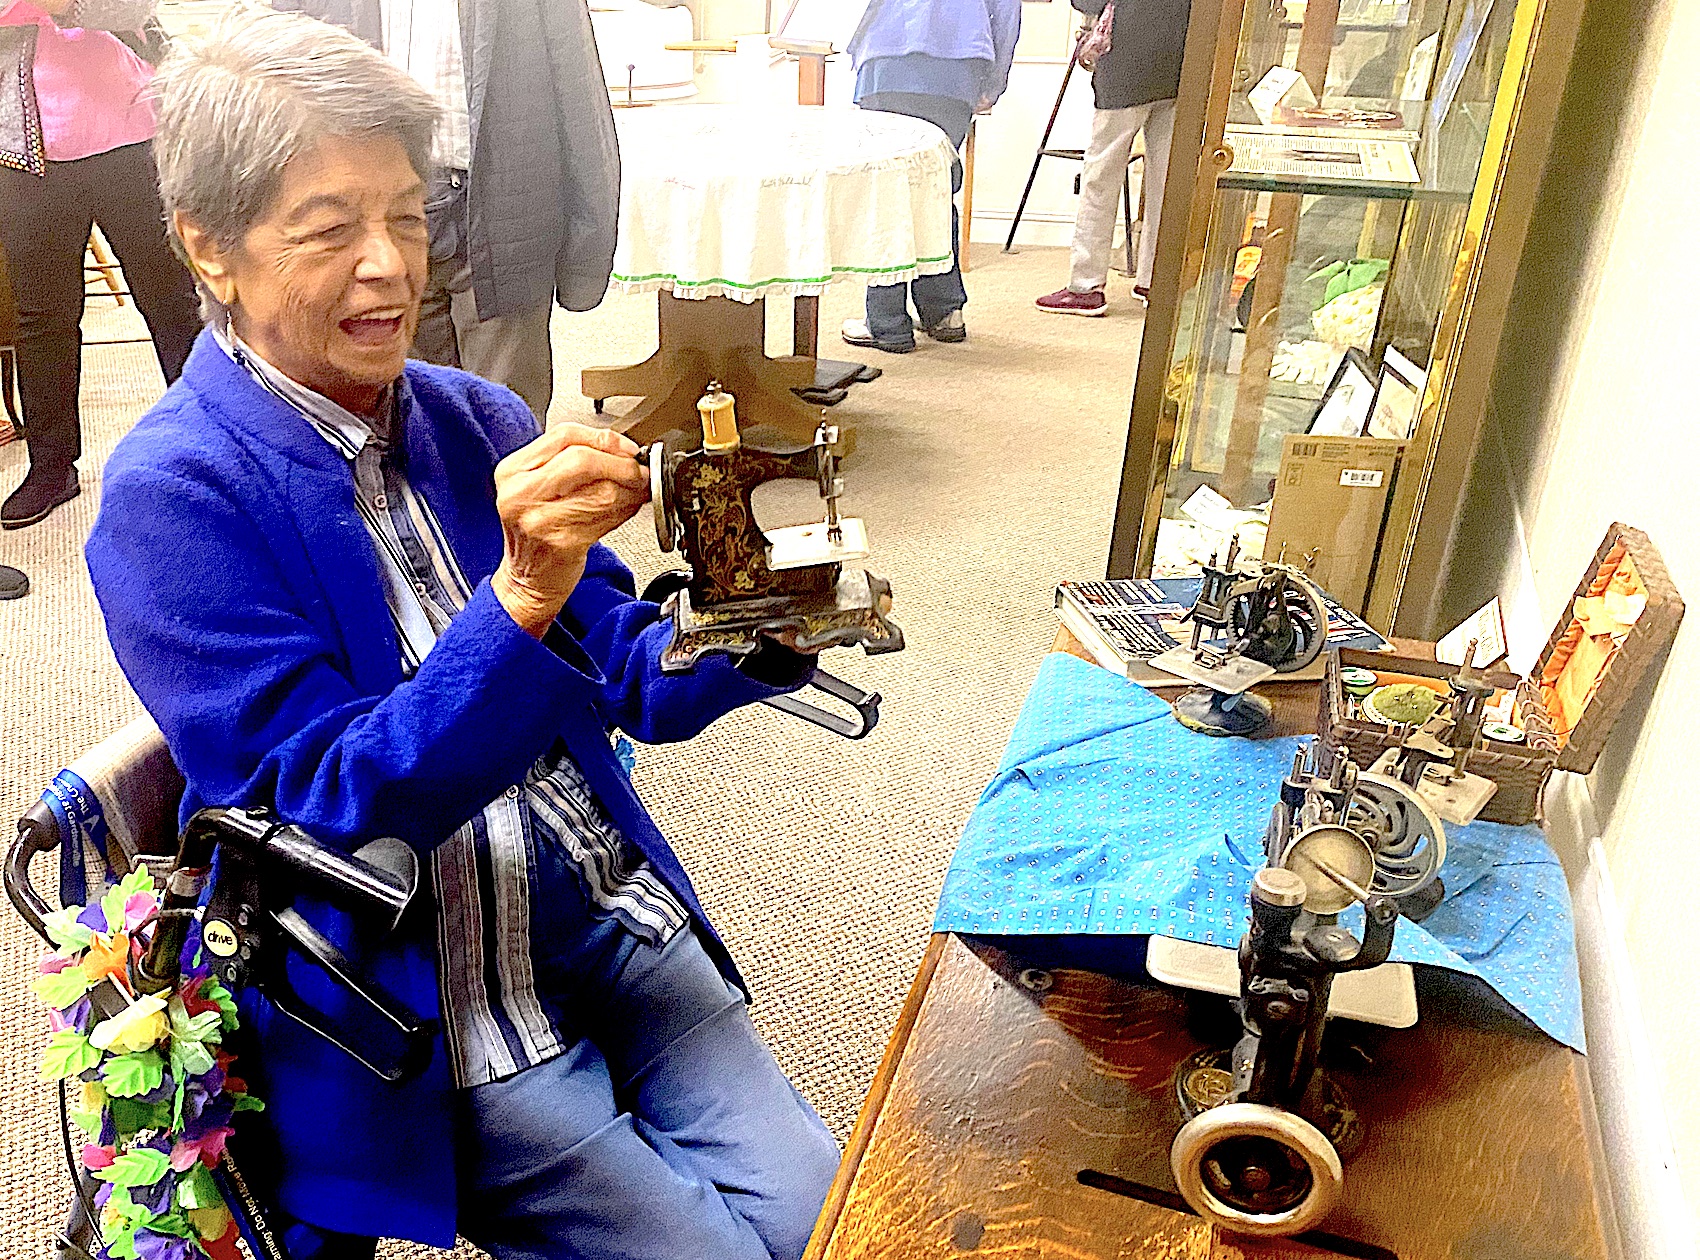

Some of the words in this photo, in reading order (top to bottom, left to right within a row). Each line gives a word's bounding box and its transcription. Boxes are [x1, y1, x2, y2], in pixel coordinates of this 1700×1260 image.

[77, 796, 89, 815] The
[207, 930, 233, 946] drive
[245, 1197, 259, 1216] Not
[254, 1214, 266, 1231] Do
[261, 1229, 283, 1260] arning:
